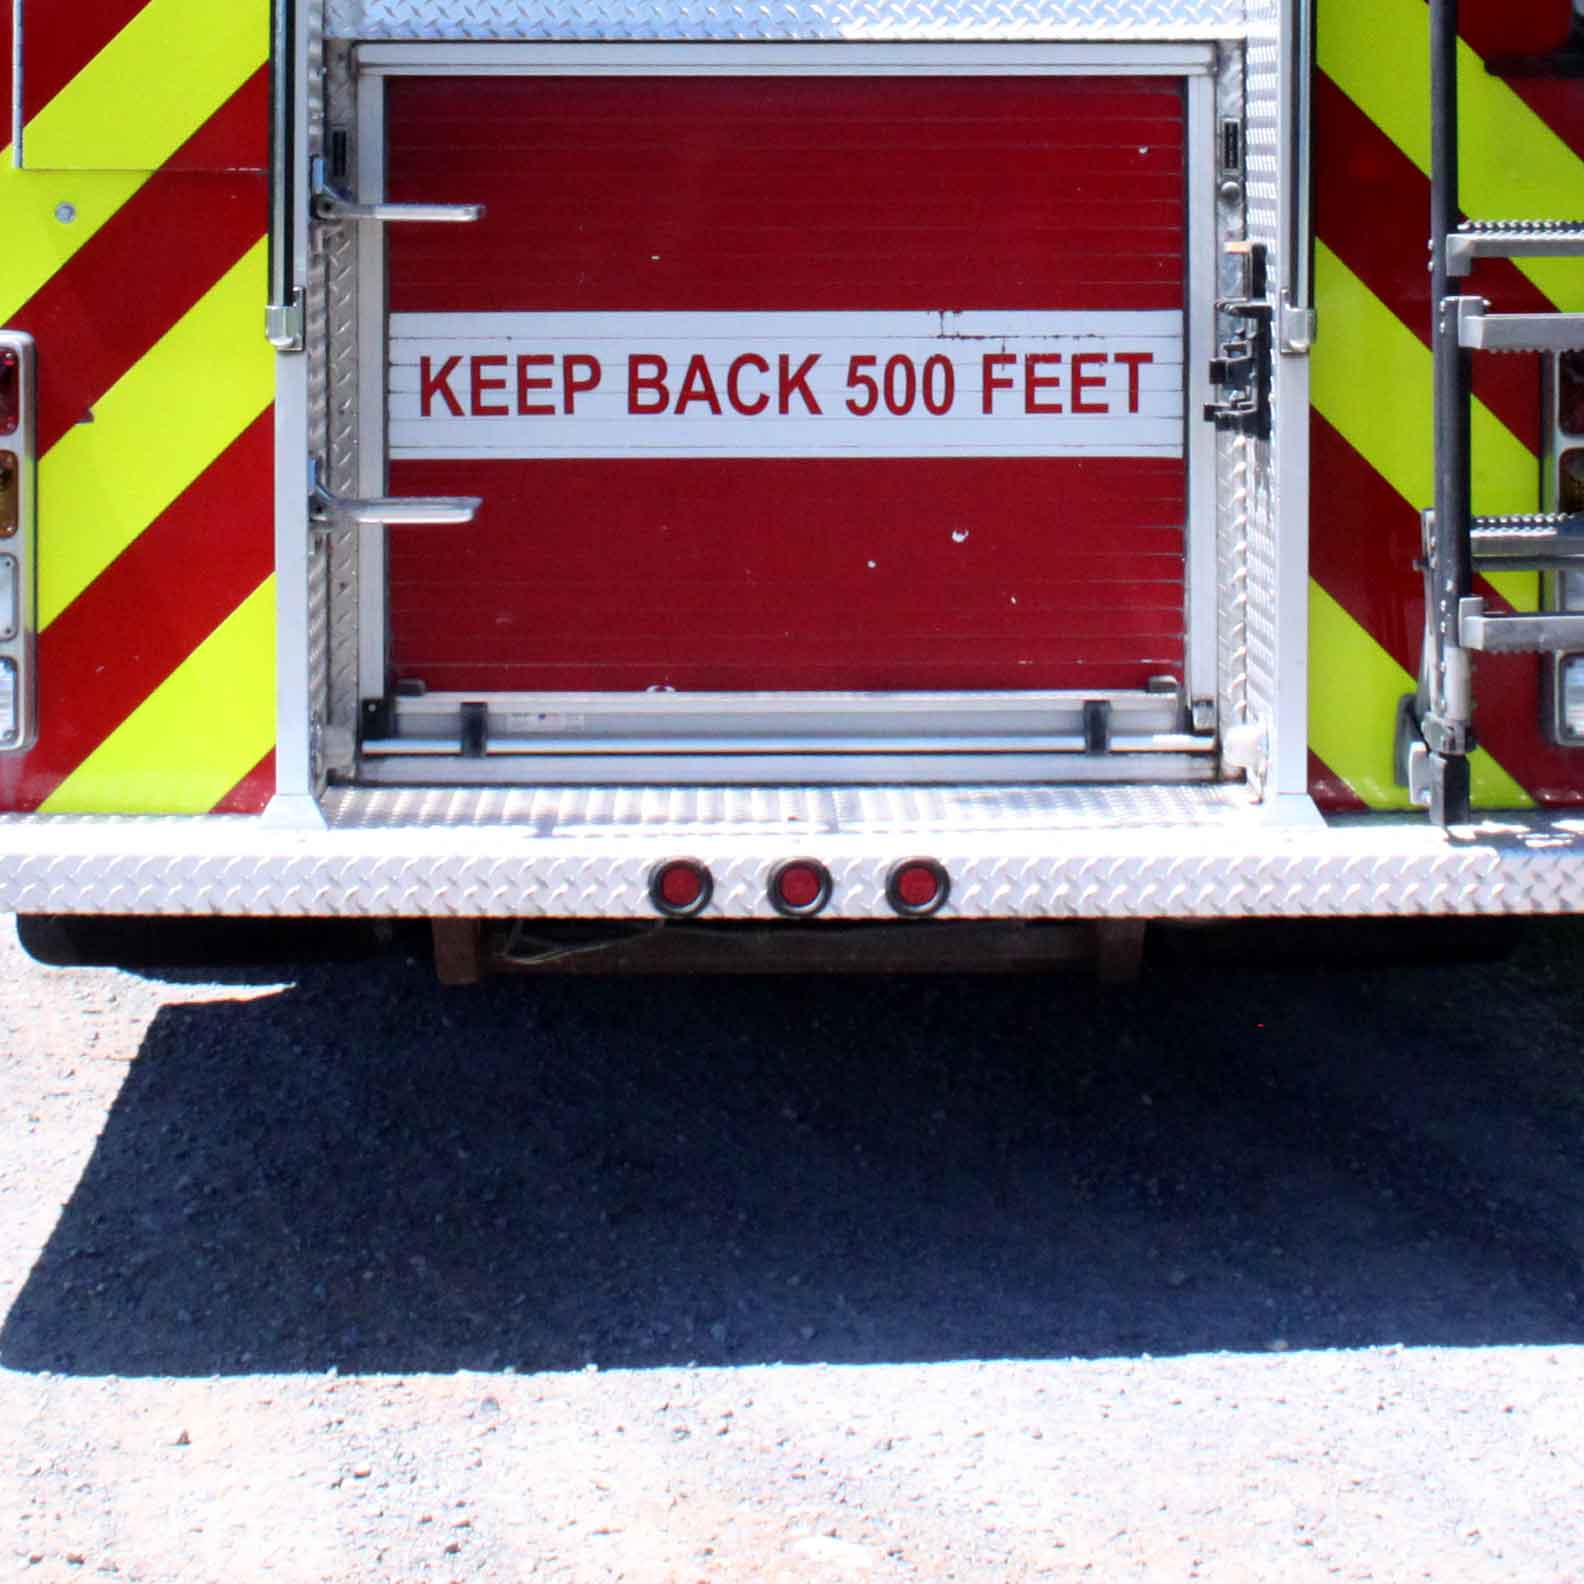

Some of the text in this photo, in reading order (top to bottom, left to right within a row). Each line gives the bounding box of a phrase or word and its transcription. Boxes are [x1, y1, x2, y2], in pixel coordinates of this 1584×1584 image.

[420, 352, 1153, 417] KEEP BACK 500 FEET
